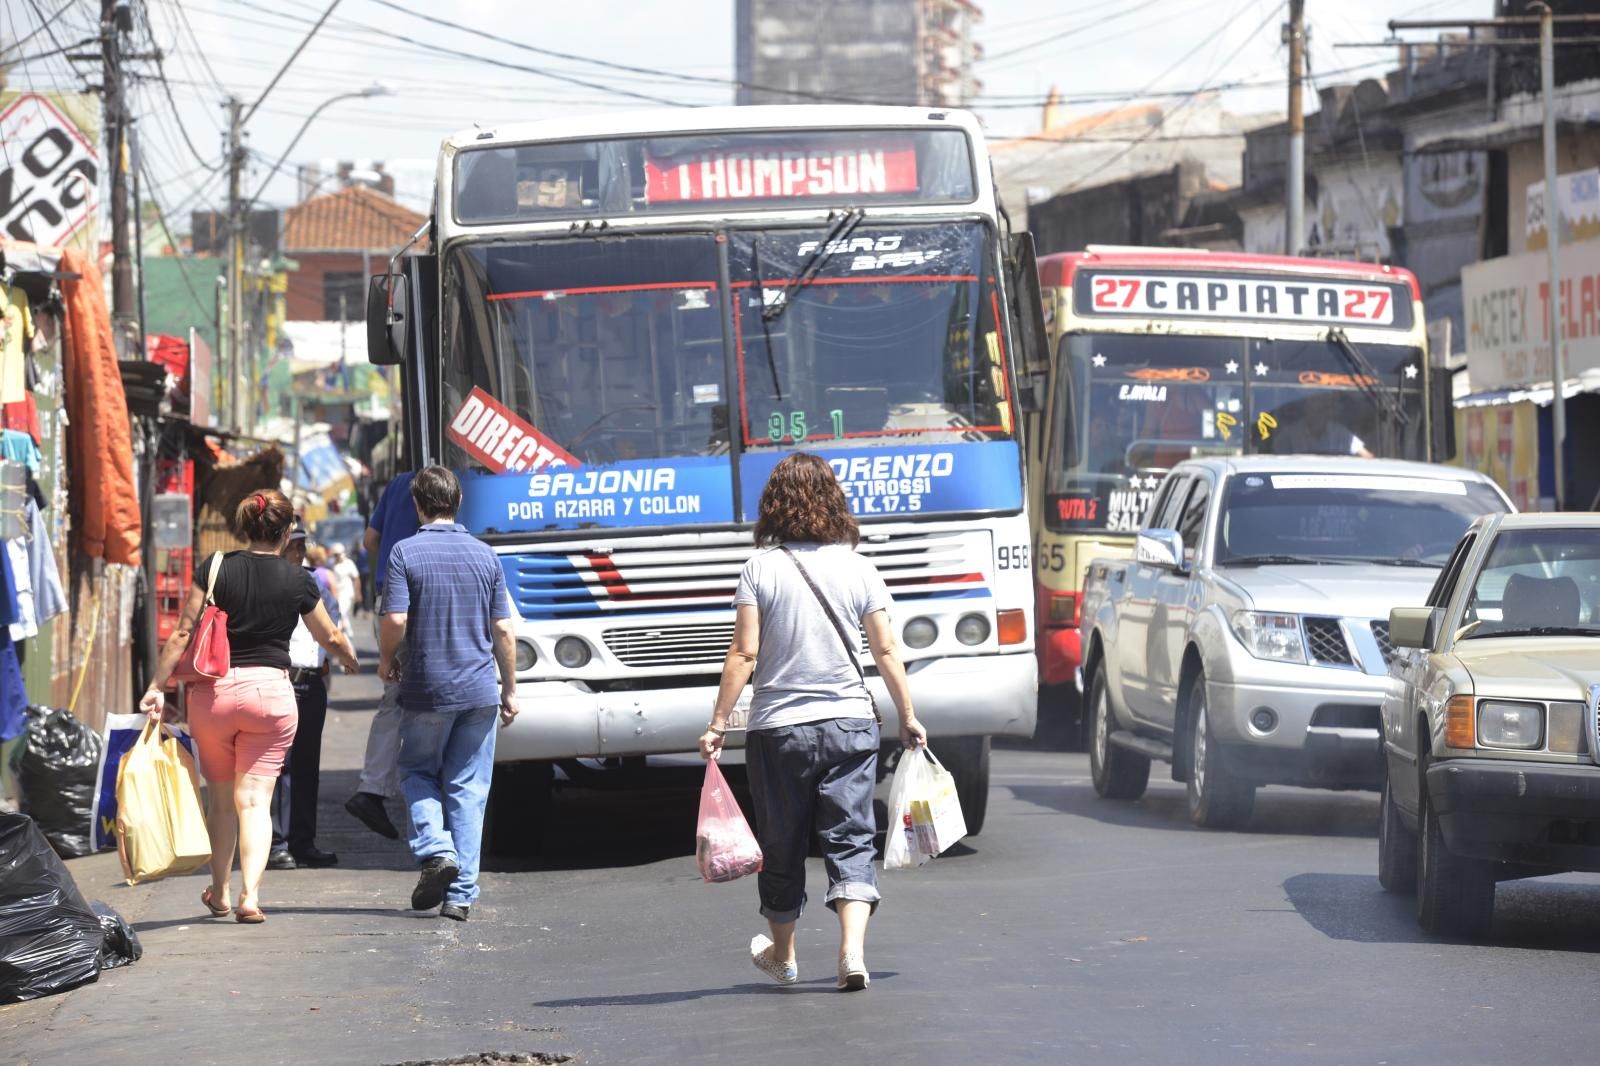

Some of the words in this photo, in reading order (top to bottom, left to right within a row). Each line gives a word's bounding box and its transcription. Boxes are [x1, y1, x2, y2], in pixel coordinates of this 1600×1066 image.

[1095, 279, 1141, 308] 27
[1145, 281, 1338, 317] CAPIATA
[1344, 289, 1390, 320] 27
[451, 394, 568, 474] DIRECT
[768, 410, 807, 442] 95
[528, 467, 676, 498] SAJONIA
[508, 501, 543, 520] POR
[555, 499, 615, 518] AZARA
[623, 498, 634, 515] Y
[640, 495, 701, 515] COLON
[1041, 543, 1066, 572] 65
